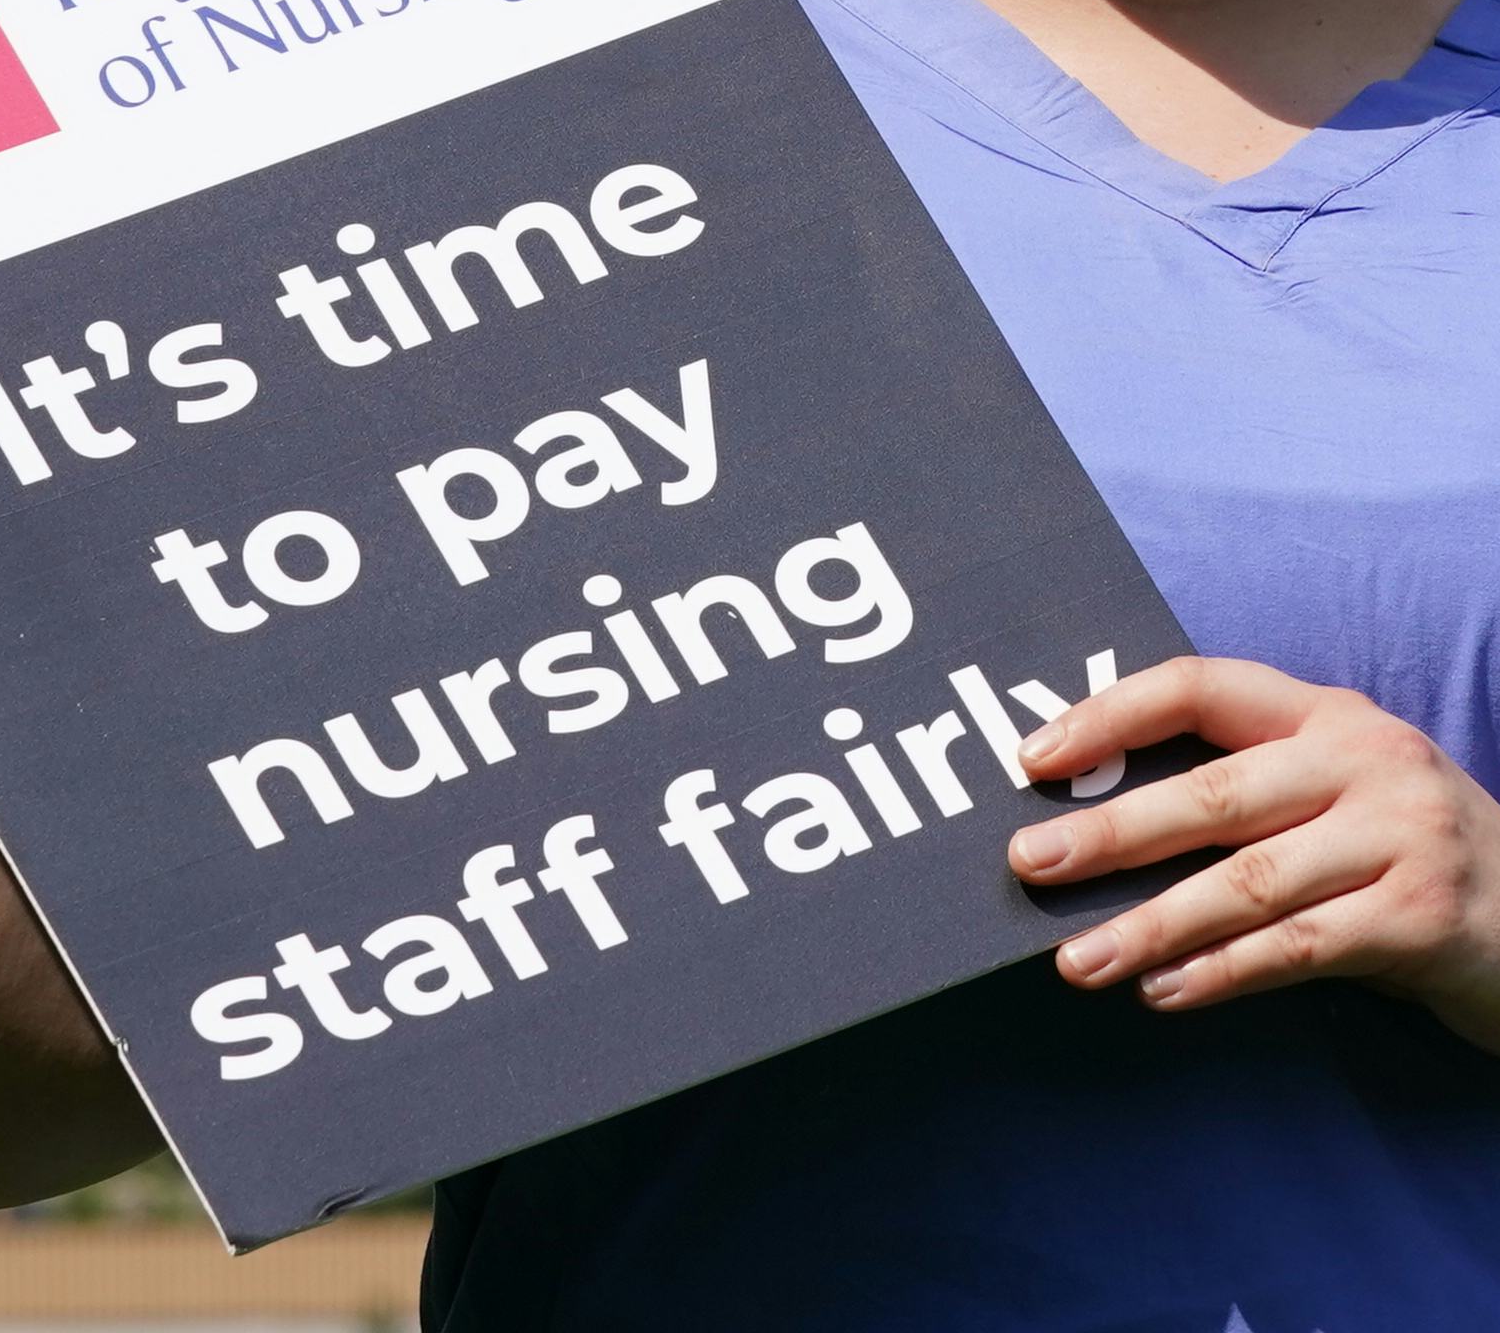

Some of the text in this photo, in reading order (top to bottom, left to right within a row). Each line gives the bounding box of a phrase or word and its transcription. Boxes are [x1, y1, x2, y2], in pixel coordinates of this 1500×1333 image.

[98, 15, 187, 109] of
[275, 163, 706, 368] time
[150, 358, 718, 634] to pay
[207, 521, 914, 850] nursing
[190, 814, 629, 1081] staff
